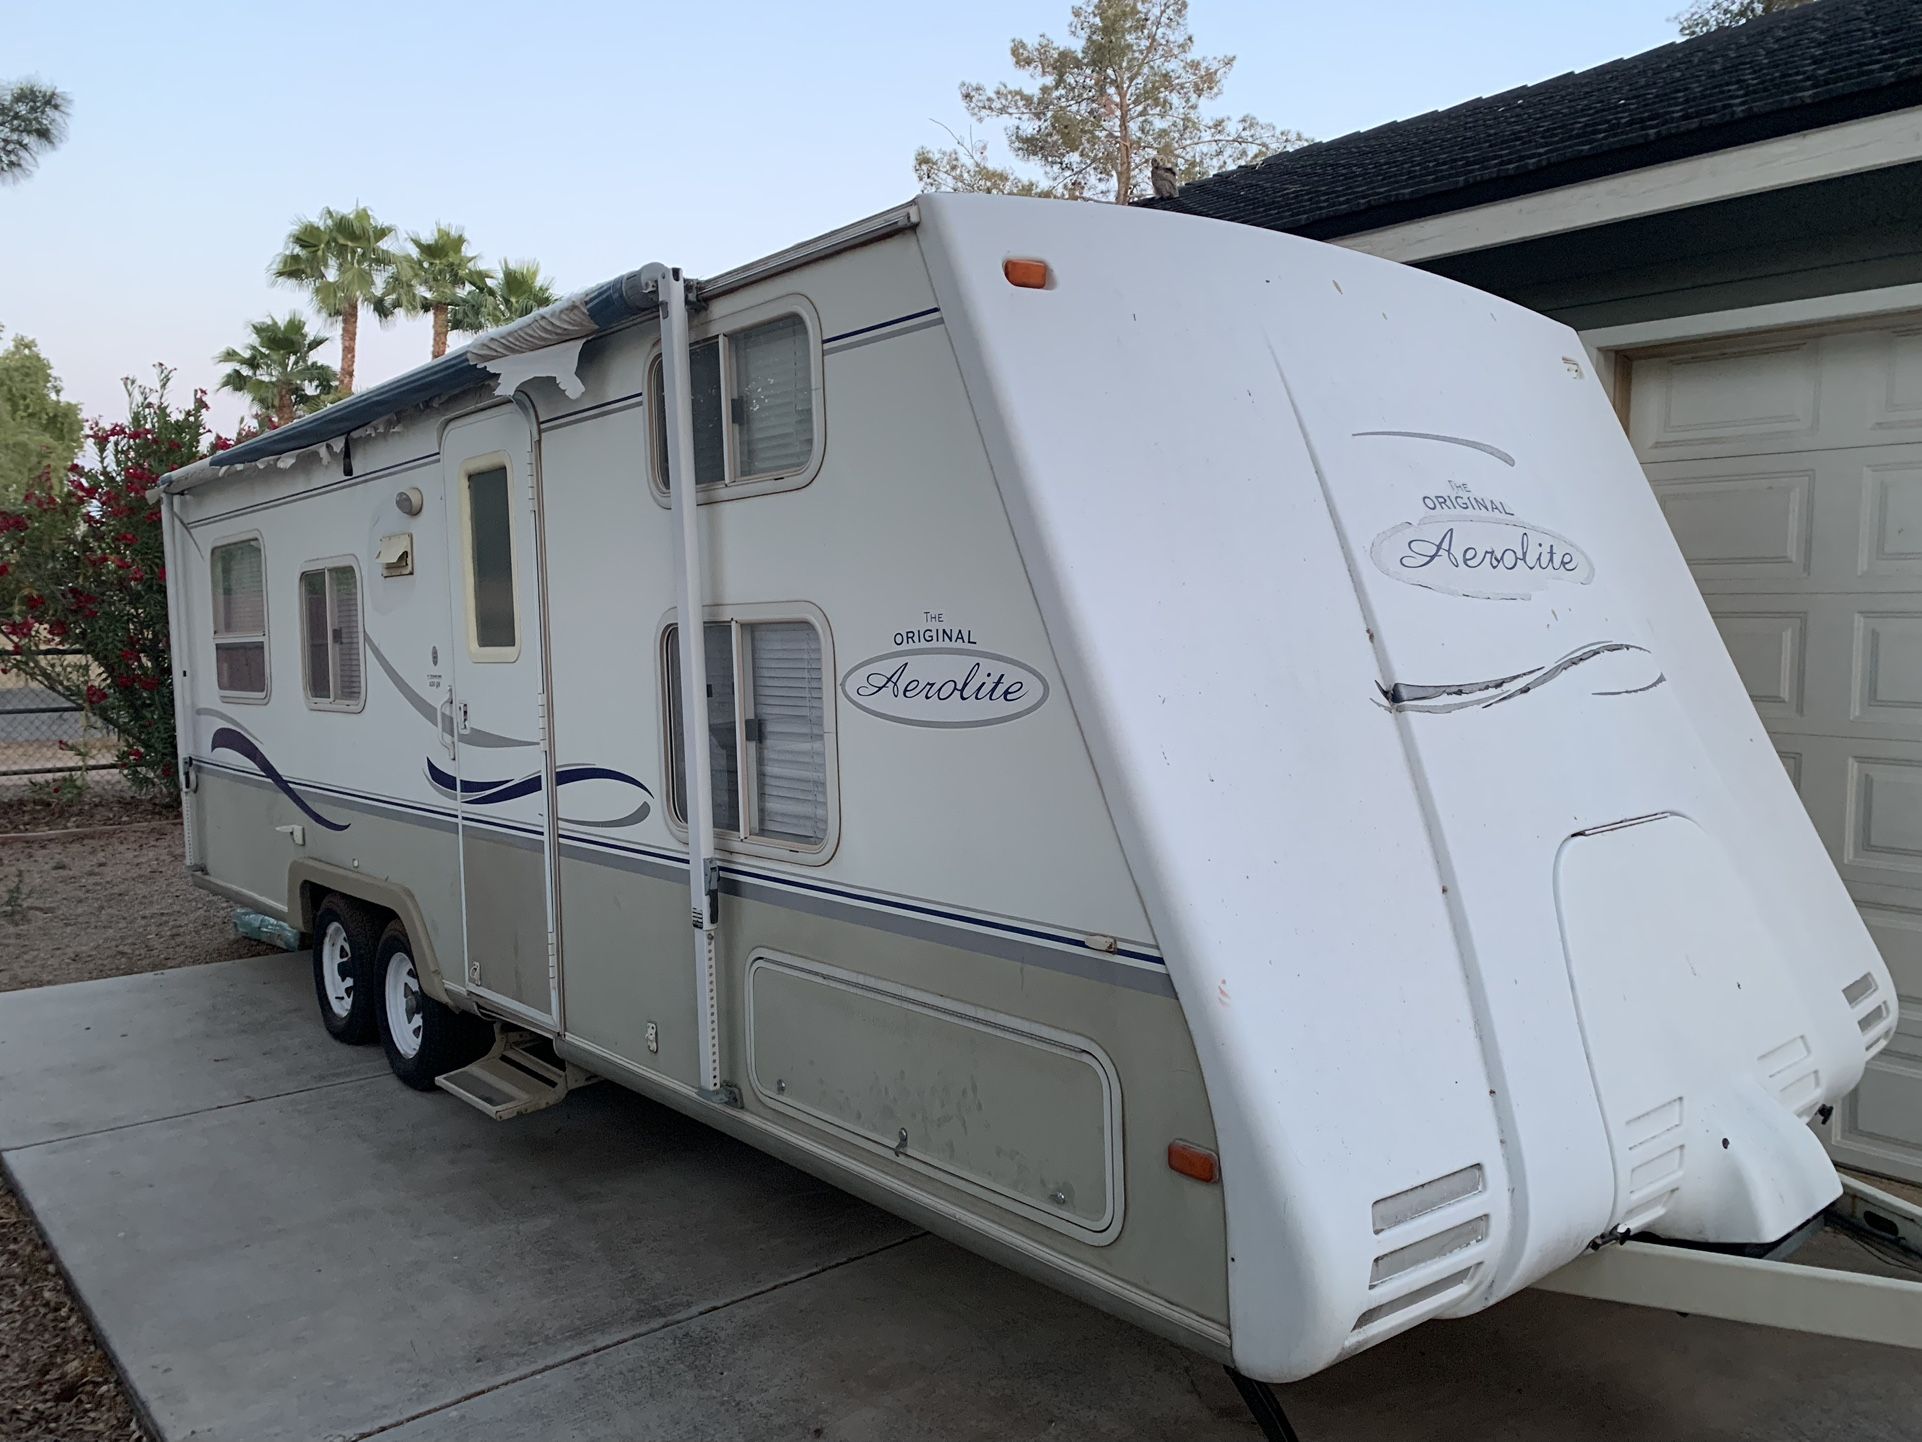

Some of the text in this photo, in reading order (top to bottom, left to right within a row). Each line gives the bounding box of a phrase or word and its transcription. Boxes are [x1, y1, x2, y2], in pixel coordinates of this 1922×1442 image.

[1422, 495, 1515, 516] ORIGINAL
[1399, 527, 1579, 572] Aerolite
[923, 611, 944, 623] THE
[893, 628, 977, 646] ORIGINAL
[856, 661, 1030, 702] Aerolite
